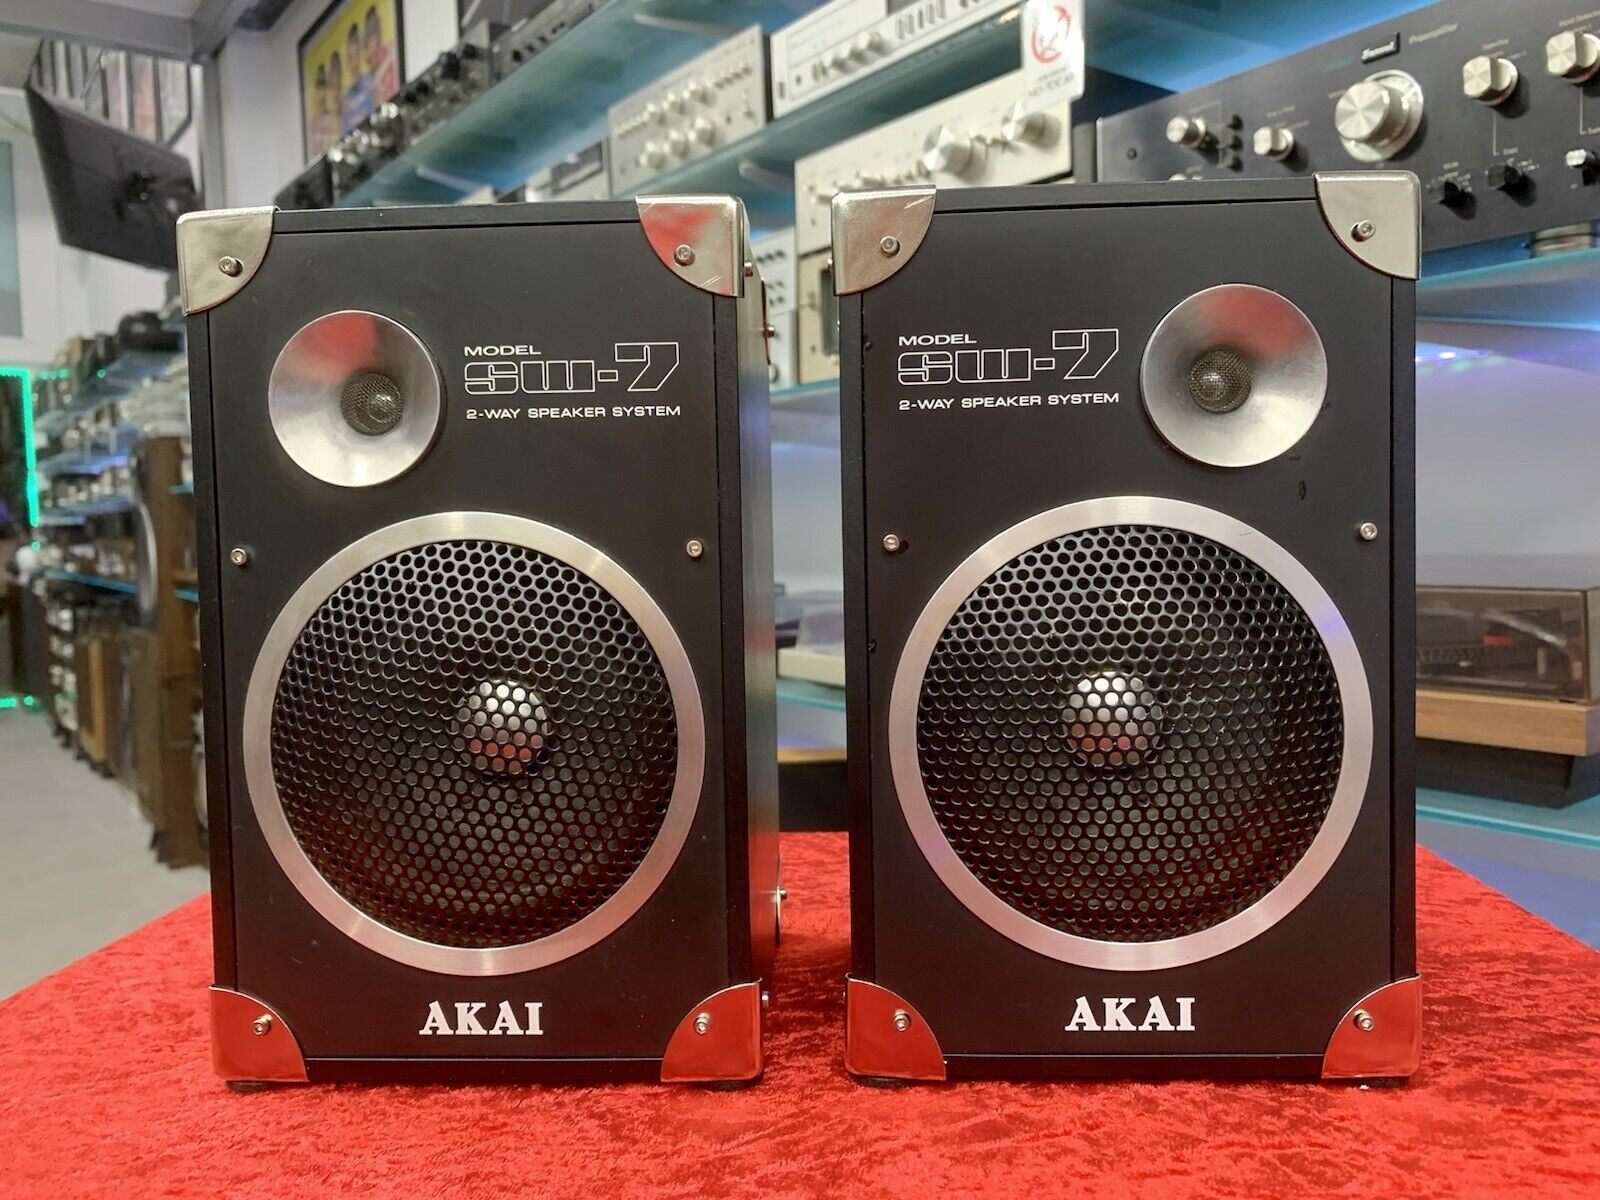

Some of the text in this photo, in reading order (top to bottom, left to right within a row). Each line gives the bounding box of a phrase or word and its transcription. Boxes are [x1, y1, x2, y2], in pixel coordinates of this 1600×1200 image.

[899, 334, 977, 346] MODEL
[464, 345, 541, 356] MODEL
[899, 393, 1119, 411] 2-WAY SPEAKER SYSTEM
[466, 405, 681, 420] 2-WAY SPEAKER SYSTEM
[419, 1000, 544, 1035] AKAI
[1064, 995, 1196, 1031] AKAI
